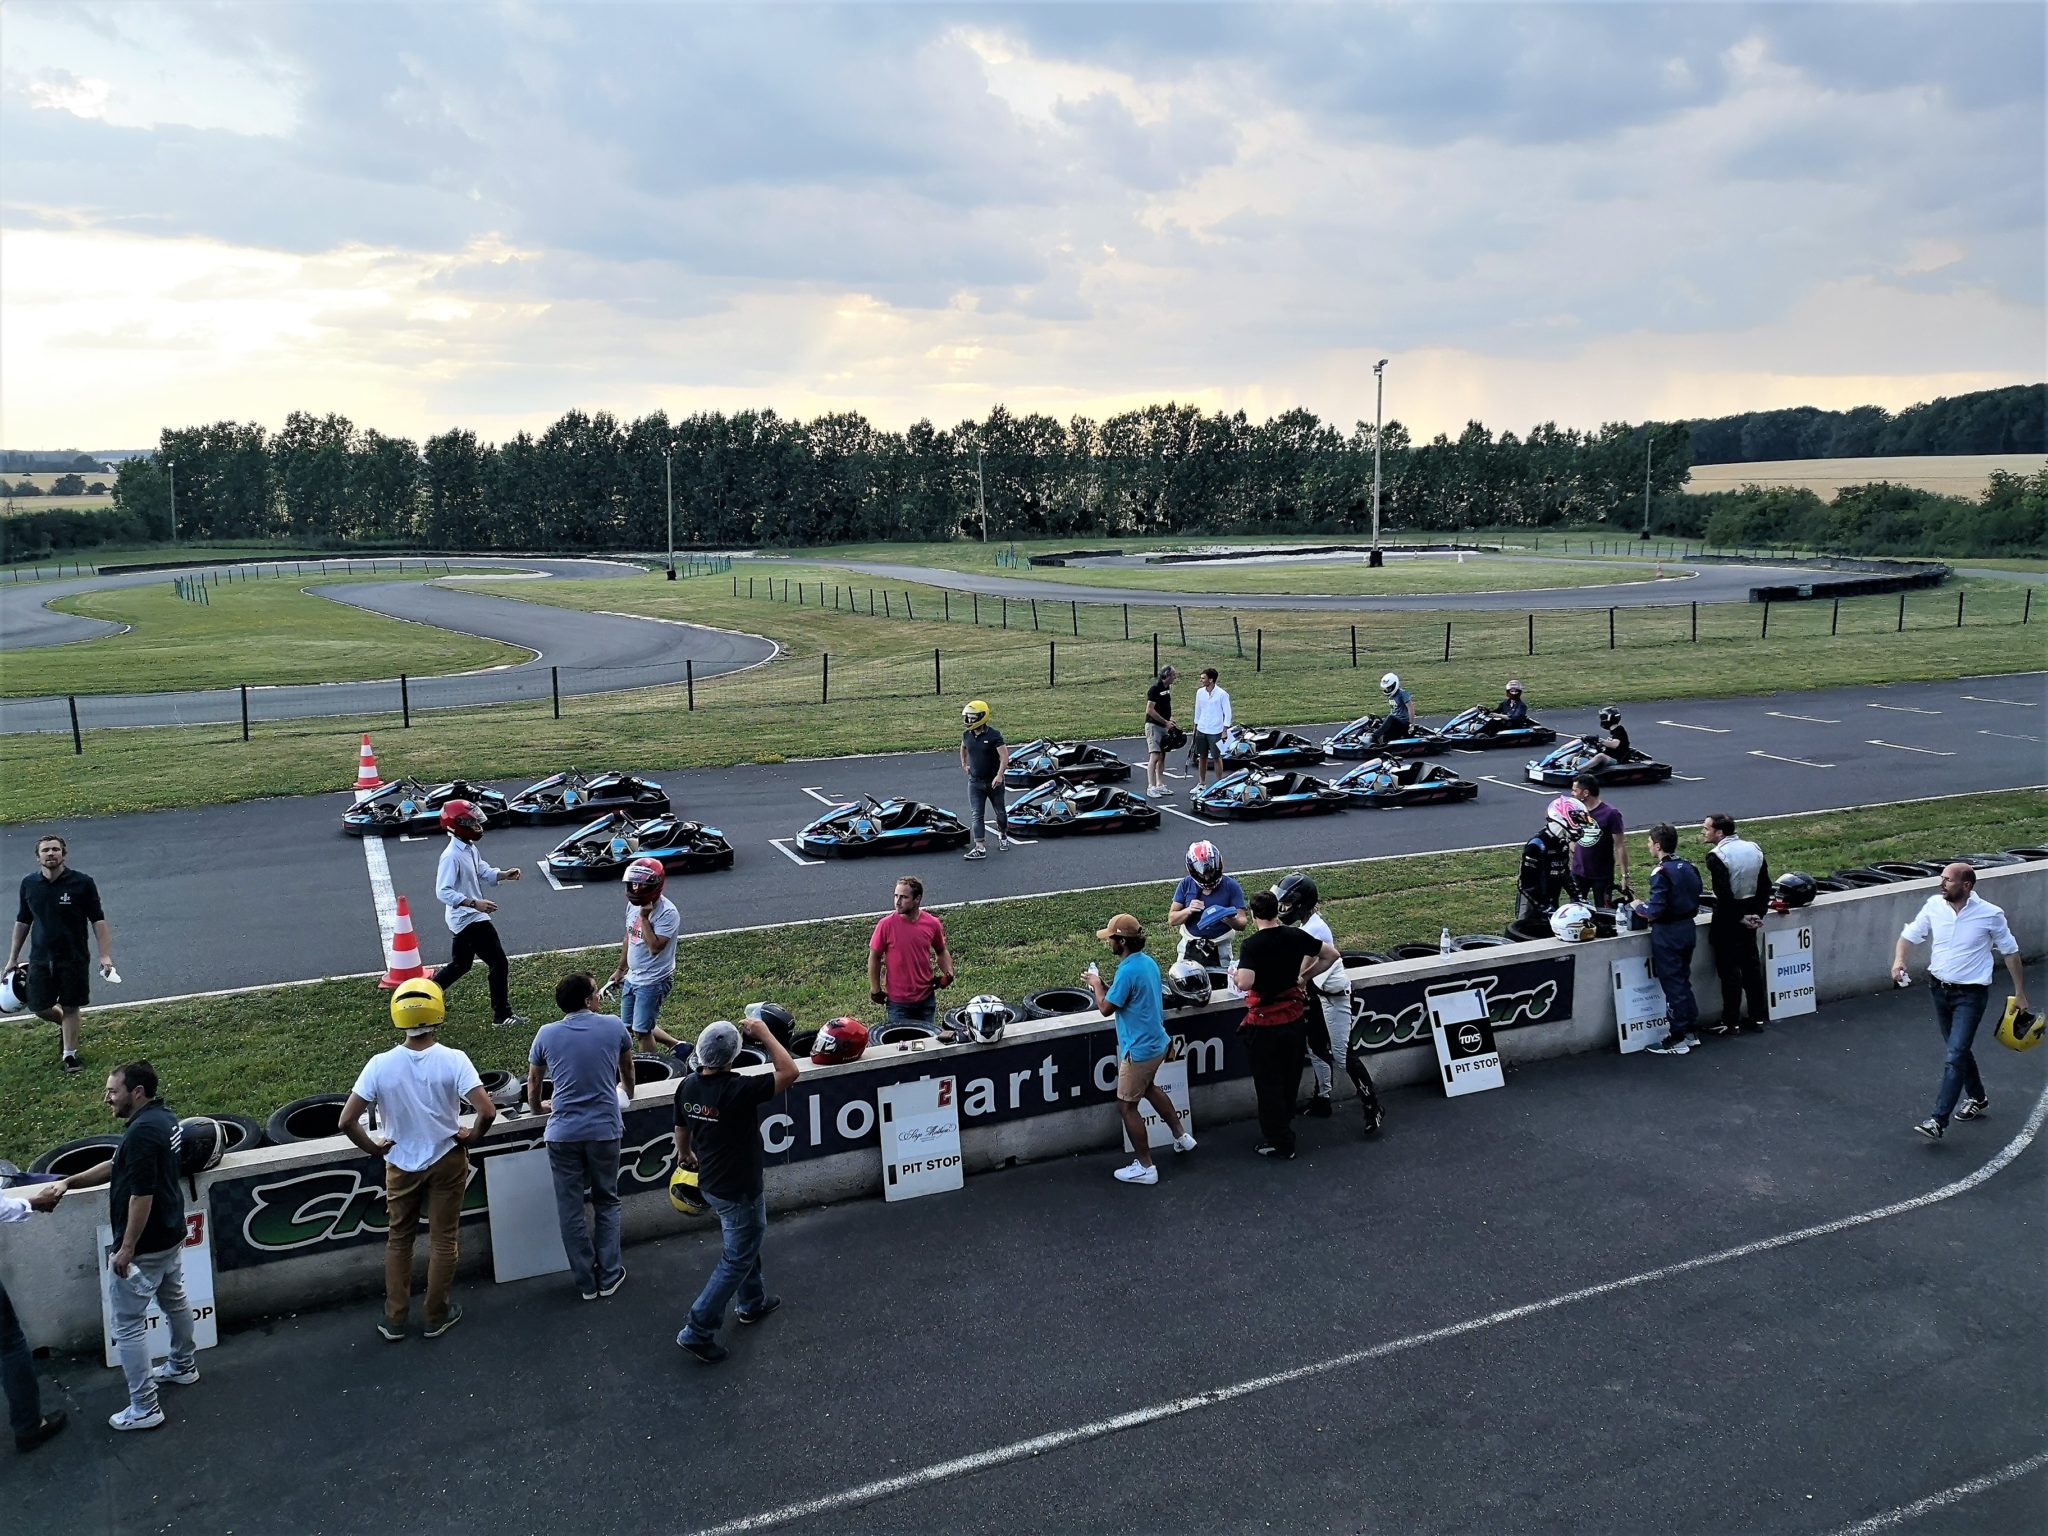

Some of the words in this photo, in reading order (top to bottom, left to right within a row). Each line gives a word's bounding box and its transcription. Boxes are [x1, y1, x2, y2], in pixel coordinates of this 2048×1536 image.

[1798, 928, 1811, 950] 16
[1777, 962, 1812, 977] PHILIPS
[1779, 990, 1792, 1001] PIT
[1793, 986, 1814, 998] STOP
[1475, 988, 1487, 1018] 1
[1630, 1022, 1644, 1032] PIT
[1646, 1018, 1668, 1029] STOP
[1460, 1033, 1481, 1045] TOYS
[1455, 1063, 1471, 1074] PIT
[1473, 1057, 1499, 1071] STOP
[938, 1079, 953, 1108] 2
[902, 1162, 923, 1176] PIT
[926, 1155, 961, 1171] STOP
